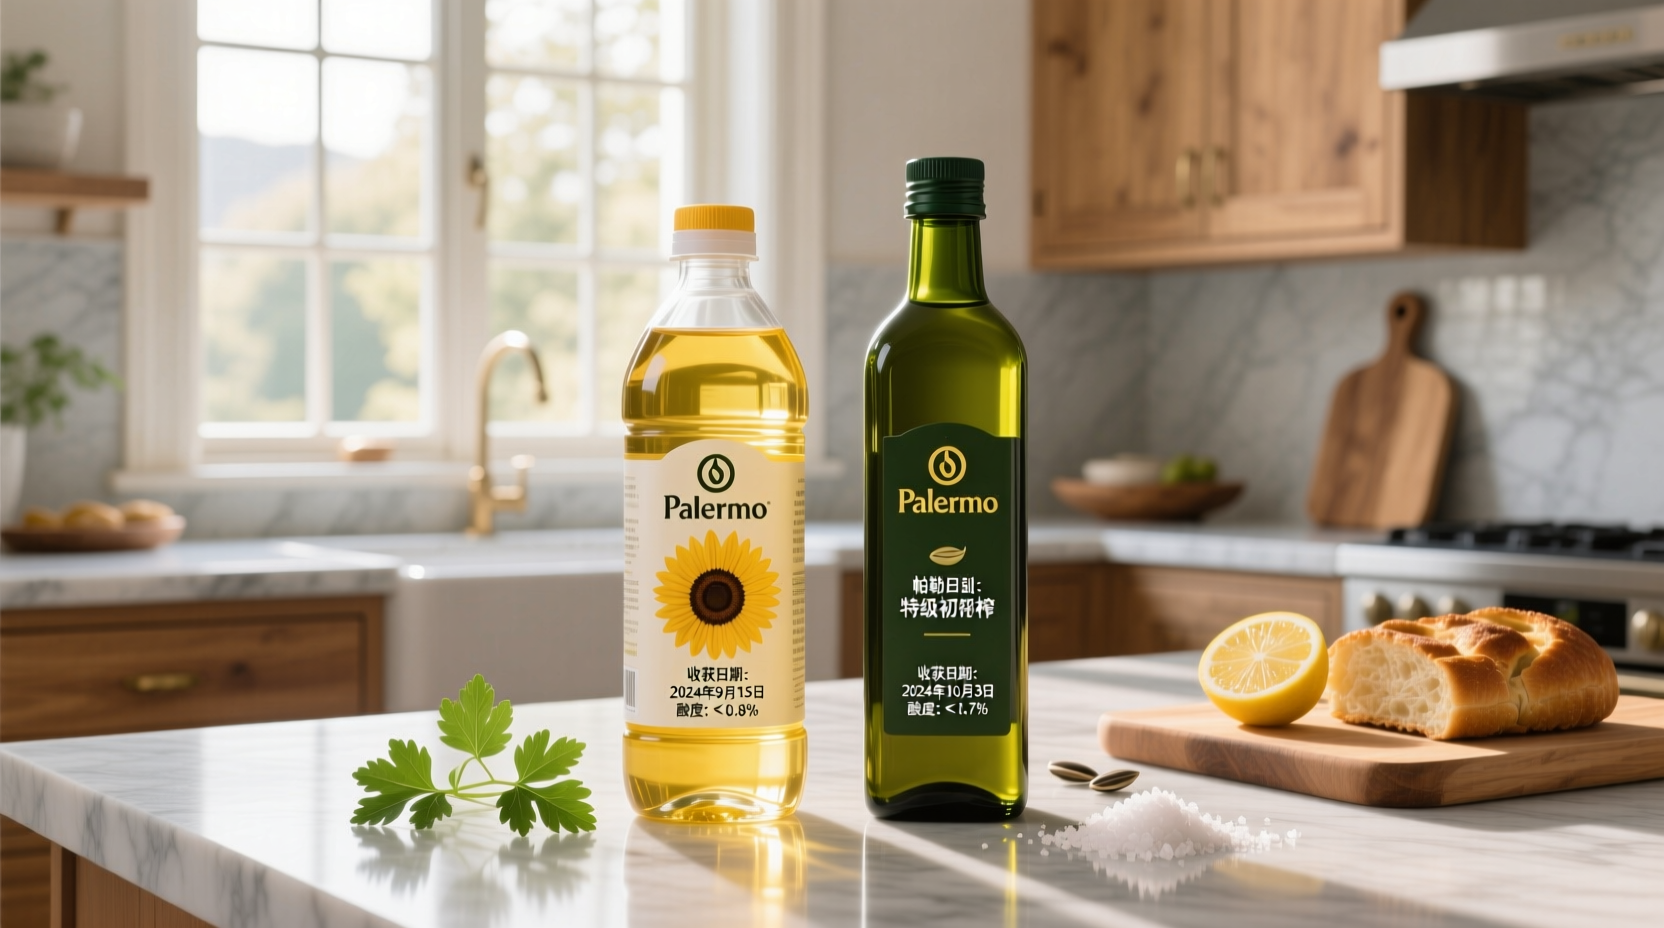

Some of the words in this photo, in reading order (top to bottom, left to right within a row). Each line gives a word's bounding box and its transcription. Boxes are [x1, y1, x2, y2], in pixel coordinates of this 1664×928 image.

[663, 494, 767, 520] Palermo
[898, 488, 998, 514] Palermo
[669, 685, 764, 701] 2024年9月15日
[901, 683, 994, 701] 2024年10月3日
